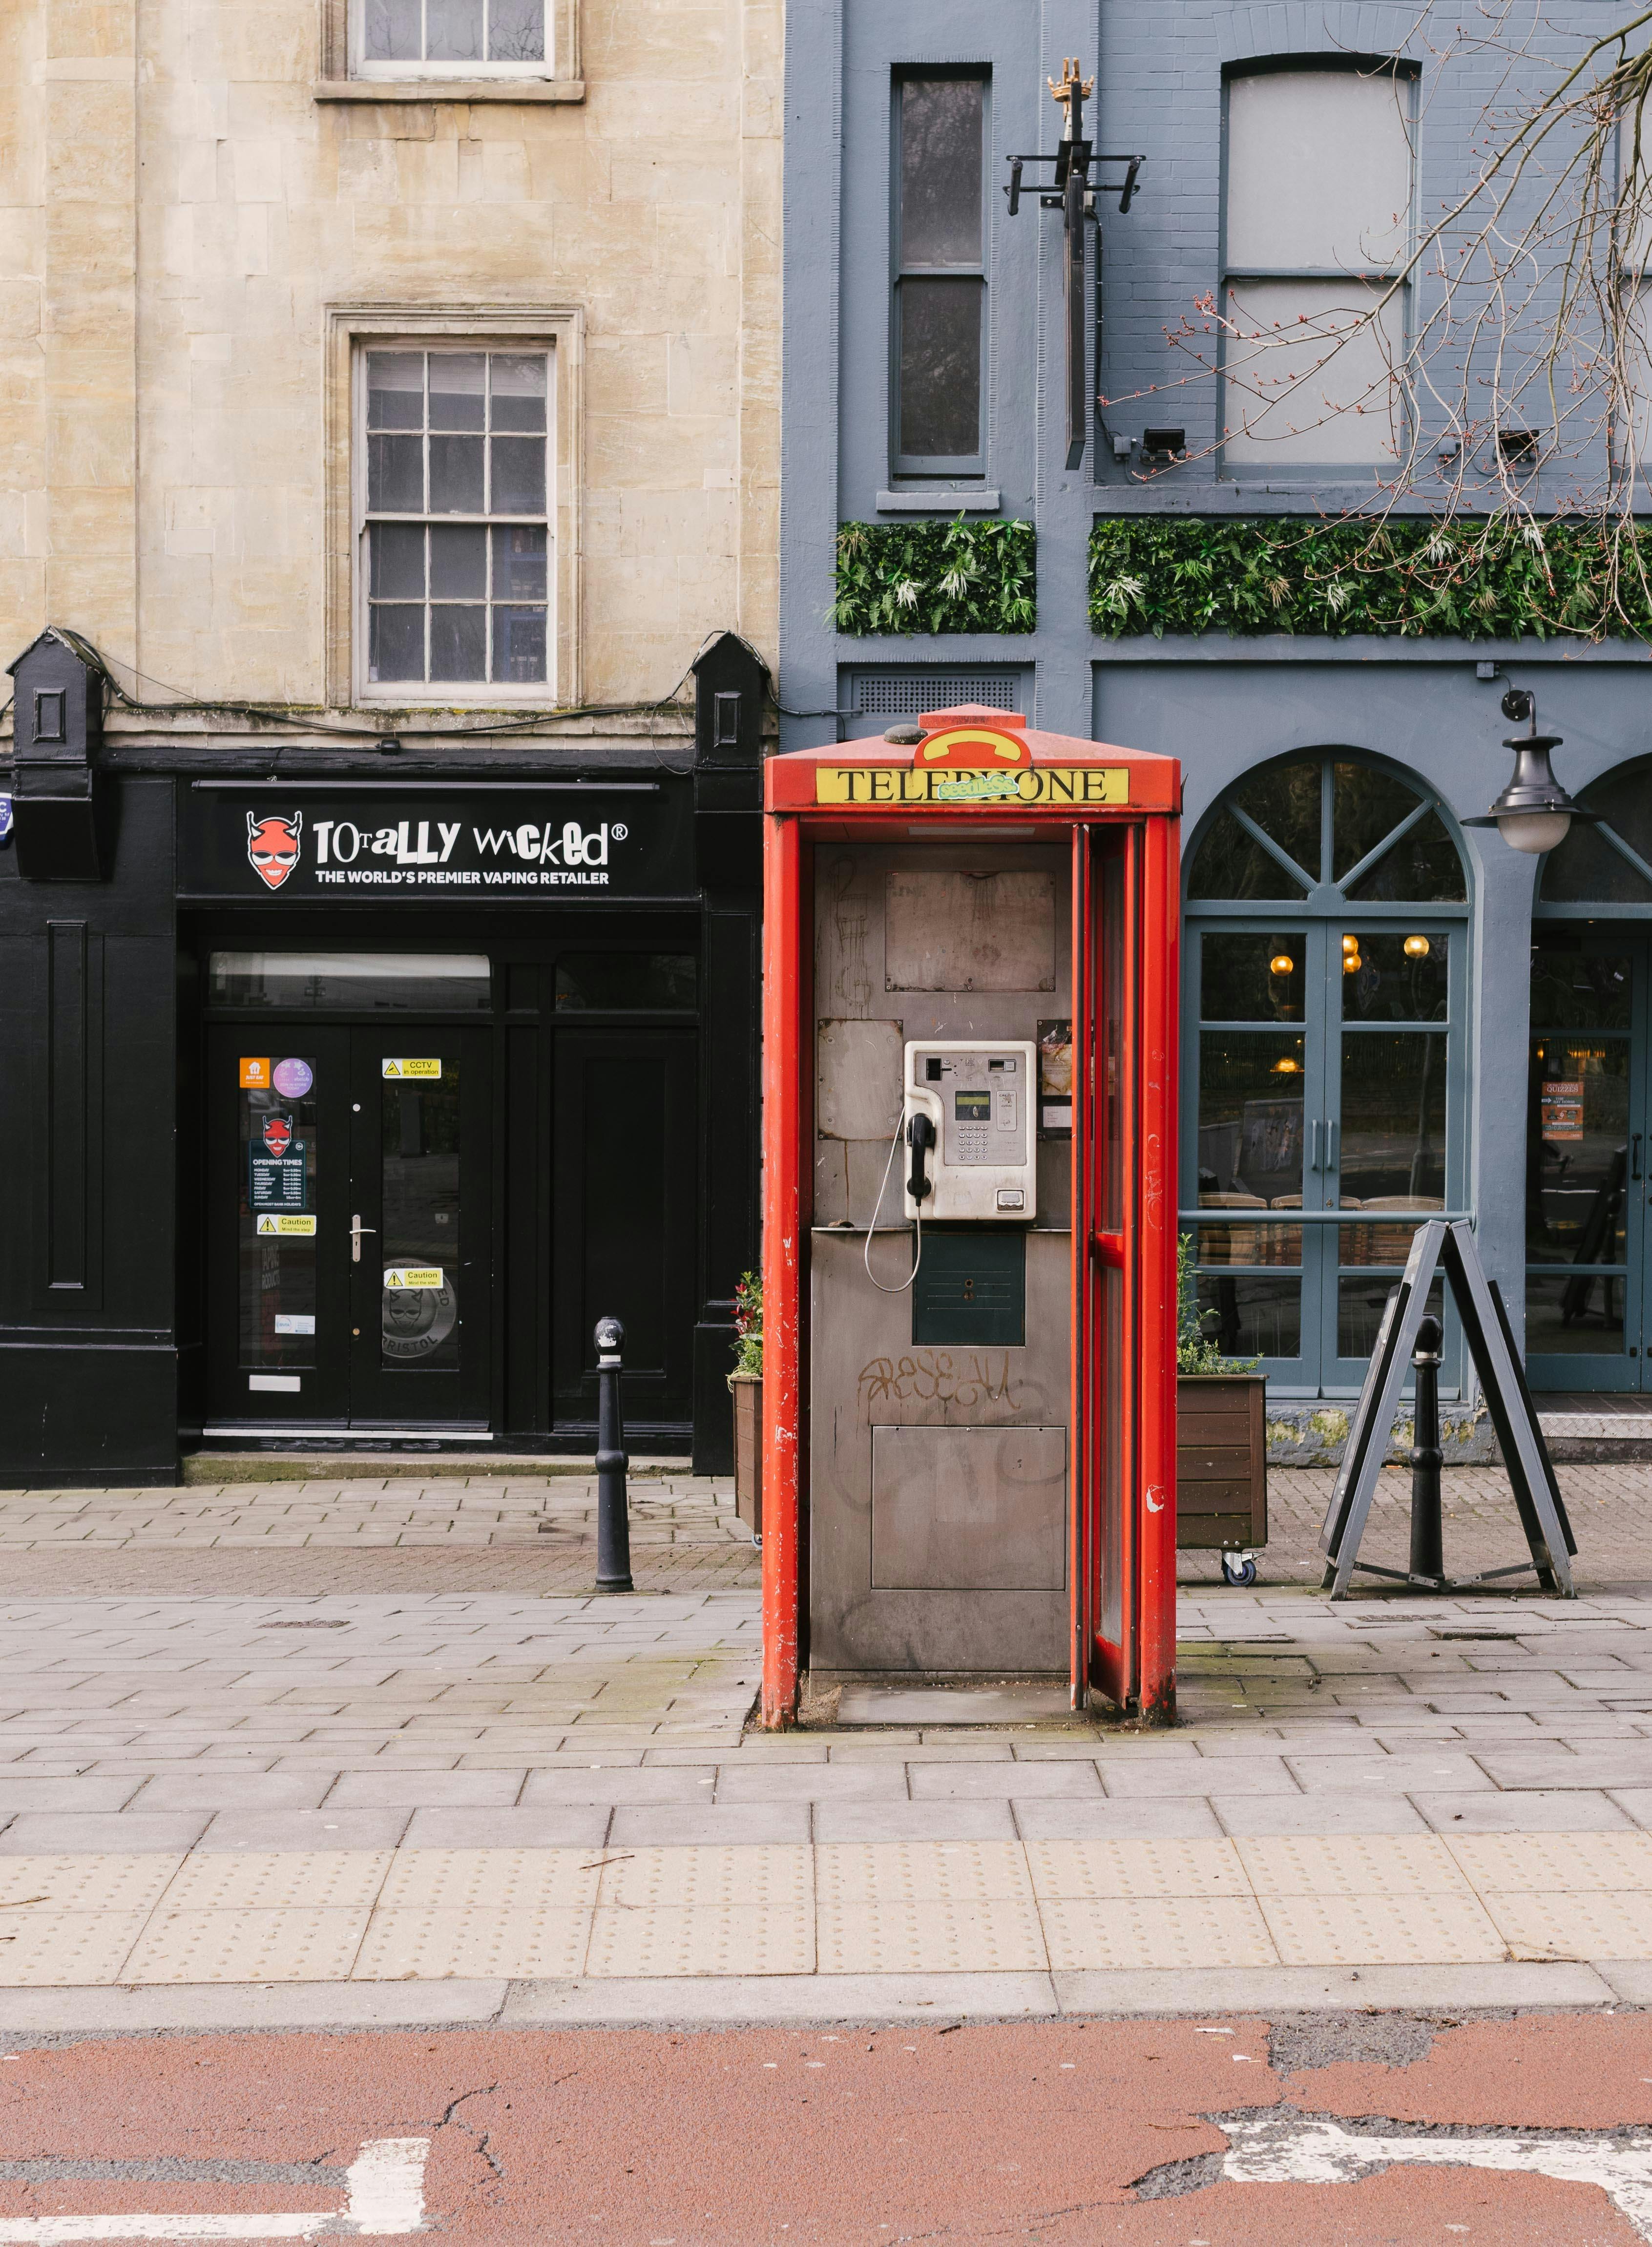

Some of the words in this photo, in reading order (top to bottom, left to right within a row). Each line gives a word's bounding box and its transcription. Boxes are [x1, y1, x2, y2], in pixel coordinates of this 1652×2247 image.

[315, 870, 345, 883] THE
[347, 871, 416, 884] WORLD'S
[418, 871, 481, 884] PREMIER
[482, 872, 538, 884] VAPING
[540, 872, 609, 884] RETAILER
